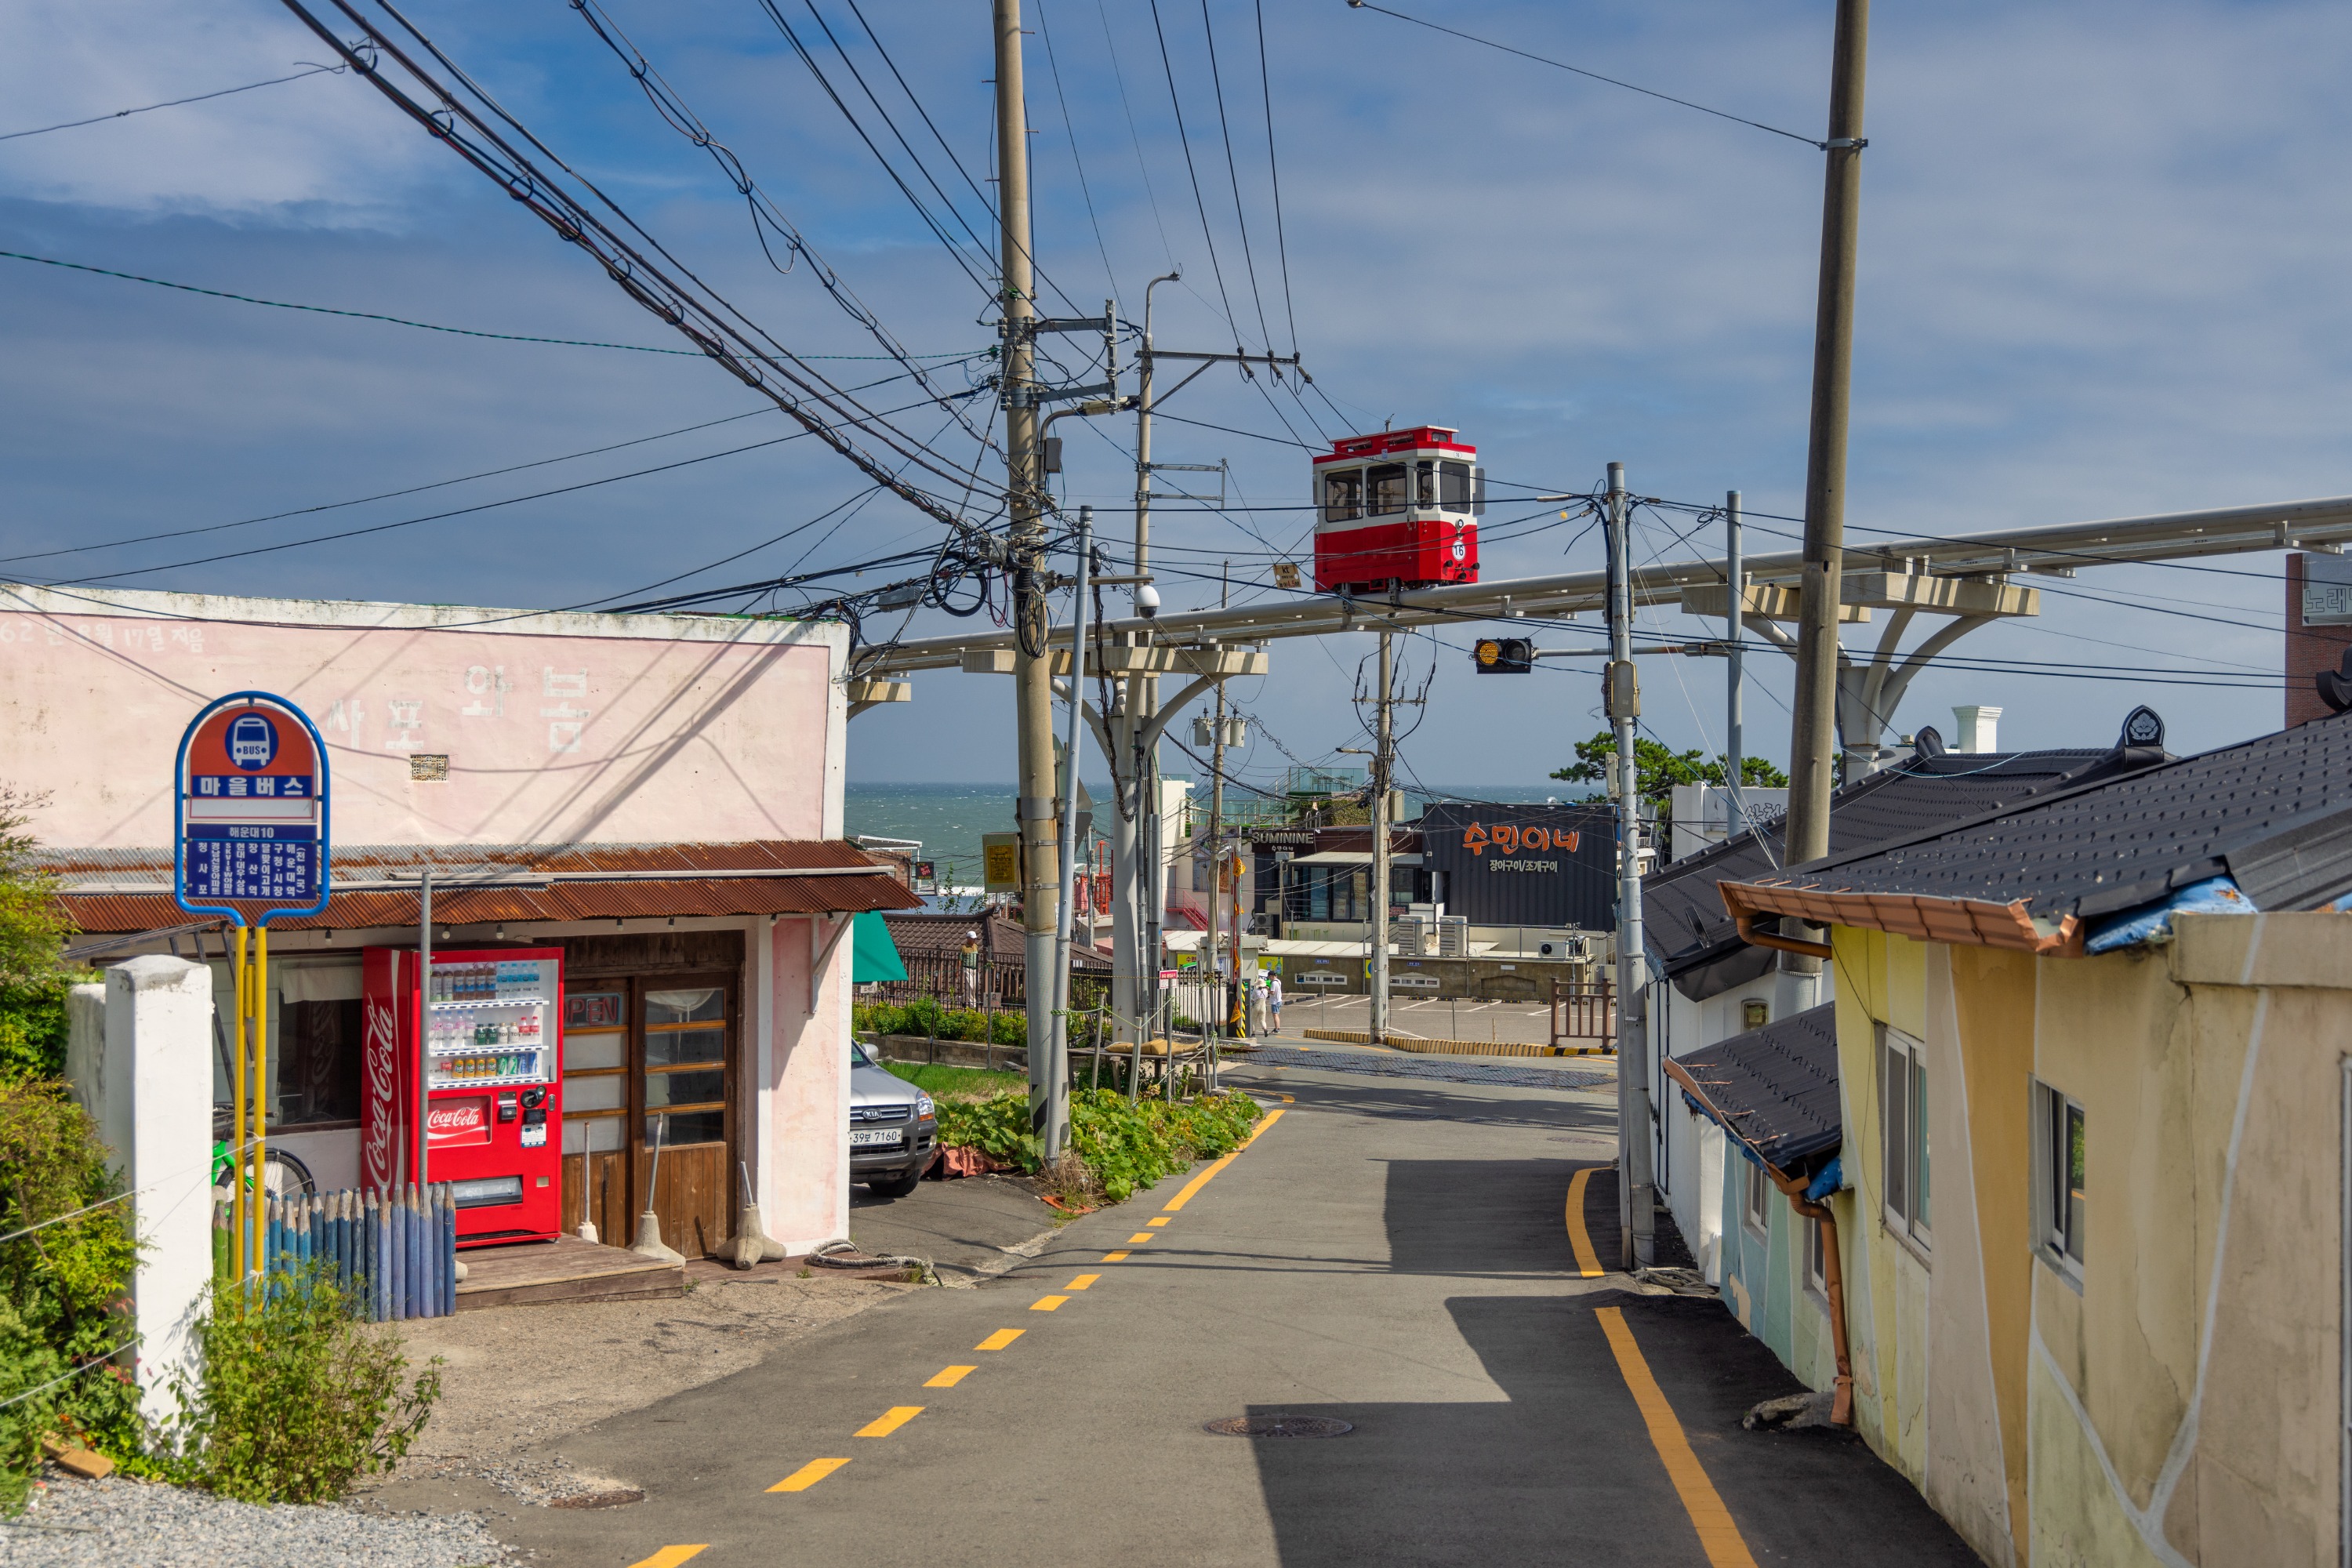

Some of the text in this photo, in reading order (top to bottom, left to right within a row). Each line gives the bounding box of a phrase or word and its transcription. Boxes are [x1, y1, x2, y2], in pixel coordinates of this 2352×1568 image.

[1454, 544, 1464, 556] 16
[1282, 565, 1290, 574] kt
[2305, 587, 2352, 613] 노래
[295, 699, 424, 750] 사포
[243, 746, 260, 755] BUS
[201, 777, 304, 796] 마을버스
[229, 826, 274, 839] 해운대10
[1251, 832, 1314, 844] SUMININE
[1462, 822, 1580, 856] 수민이네
[1490, 859, 1558, 873] 장어구이/조개구이
[366, 991, 394, 1192] Coca-Cola
[427, 1105, 481, 1129] Coca-Cola
[853, 1131, 897, 1142] 39보 7160
